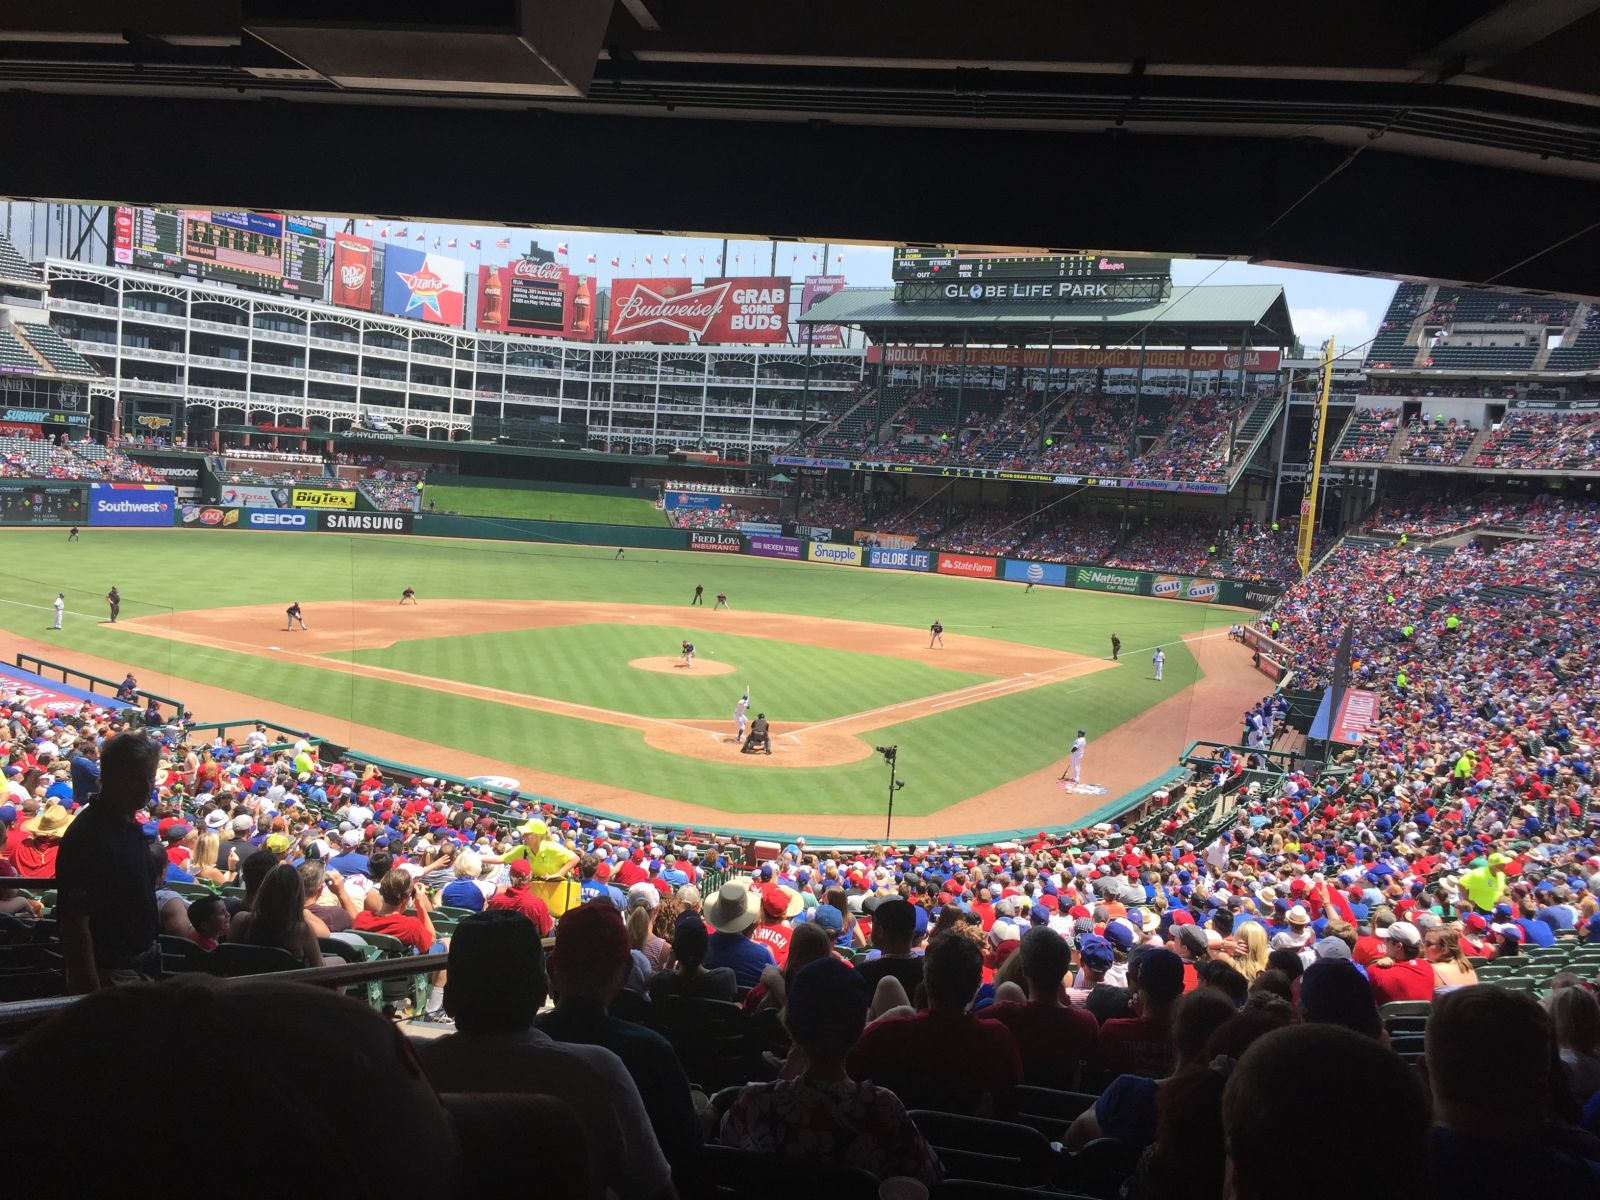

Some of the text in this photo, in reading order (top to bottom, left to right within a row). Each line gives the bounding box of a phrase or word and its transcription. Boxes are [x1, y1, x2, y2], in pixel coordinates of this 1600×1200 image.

[407, 276, 444, 289] Ozarka
[732, 288, 785, 305] GRAB
[1013, 283, 1053, 298] LIFE
[1058, 282, 1108, 297] PARK
[616, 296, 724, 319] Budweiser
[740, 304, 774, 315] SOME
[730, 315, 782, 330] BUDS
[932, 349, 952, 362] THE
[981, 350, 1019, 363] SAUCE
[1057, 351, 1080, 365] THE
[1084, 351, 1124, 365] ICONIC
[1189, 352, 1217, 367] CAP
[3, 409, 50, 422] SUBWAY
[68, 415, 87, 424] MPH
[356, 432, 394, 440] HYUNDAI
[1053, 476, 1082, 484] SUBWAY
[1099, 479, 1117, 487] MPH
[1136, 480, 1169, 491] Academy
[1185, 483, 1220, 492] Academy
[240, 492, 269, 501] TOTAL
[98, 499, 160, 513] Southwest
[203, 512, 219, 520] DQ
[250, 512, 306, 526] GEICO
[327, 514, 404, 530] SAMSUNG
[692, 531, 716, 544] FRED
[717, 533, 741, 545] LOYA
[691, 543, 740, 552] INSURANCE
[762, 543, 800, 553] NEXEN TIRE
[814, 543, 856, 562] Snapple
[881, 552, 928, 568] GLOBE LIFE
[1090, 572, 1139, 587] National
[1154, 580, 1181, 593] Gulf
[1188, 583, 1217, 597] Gulf
[752, 927, 788, 950] RVISH
